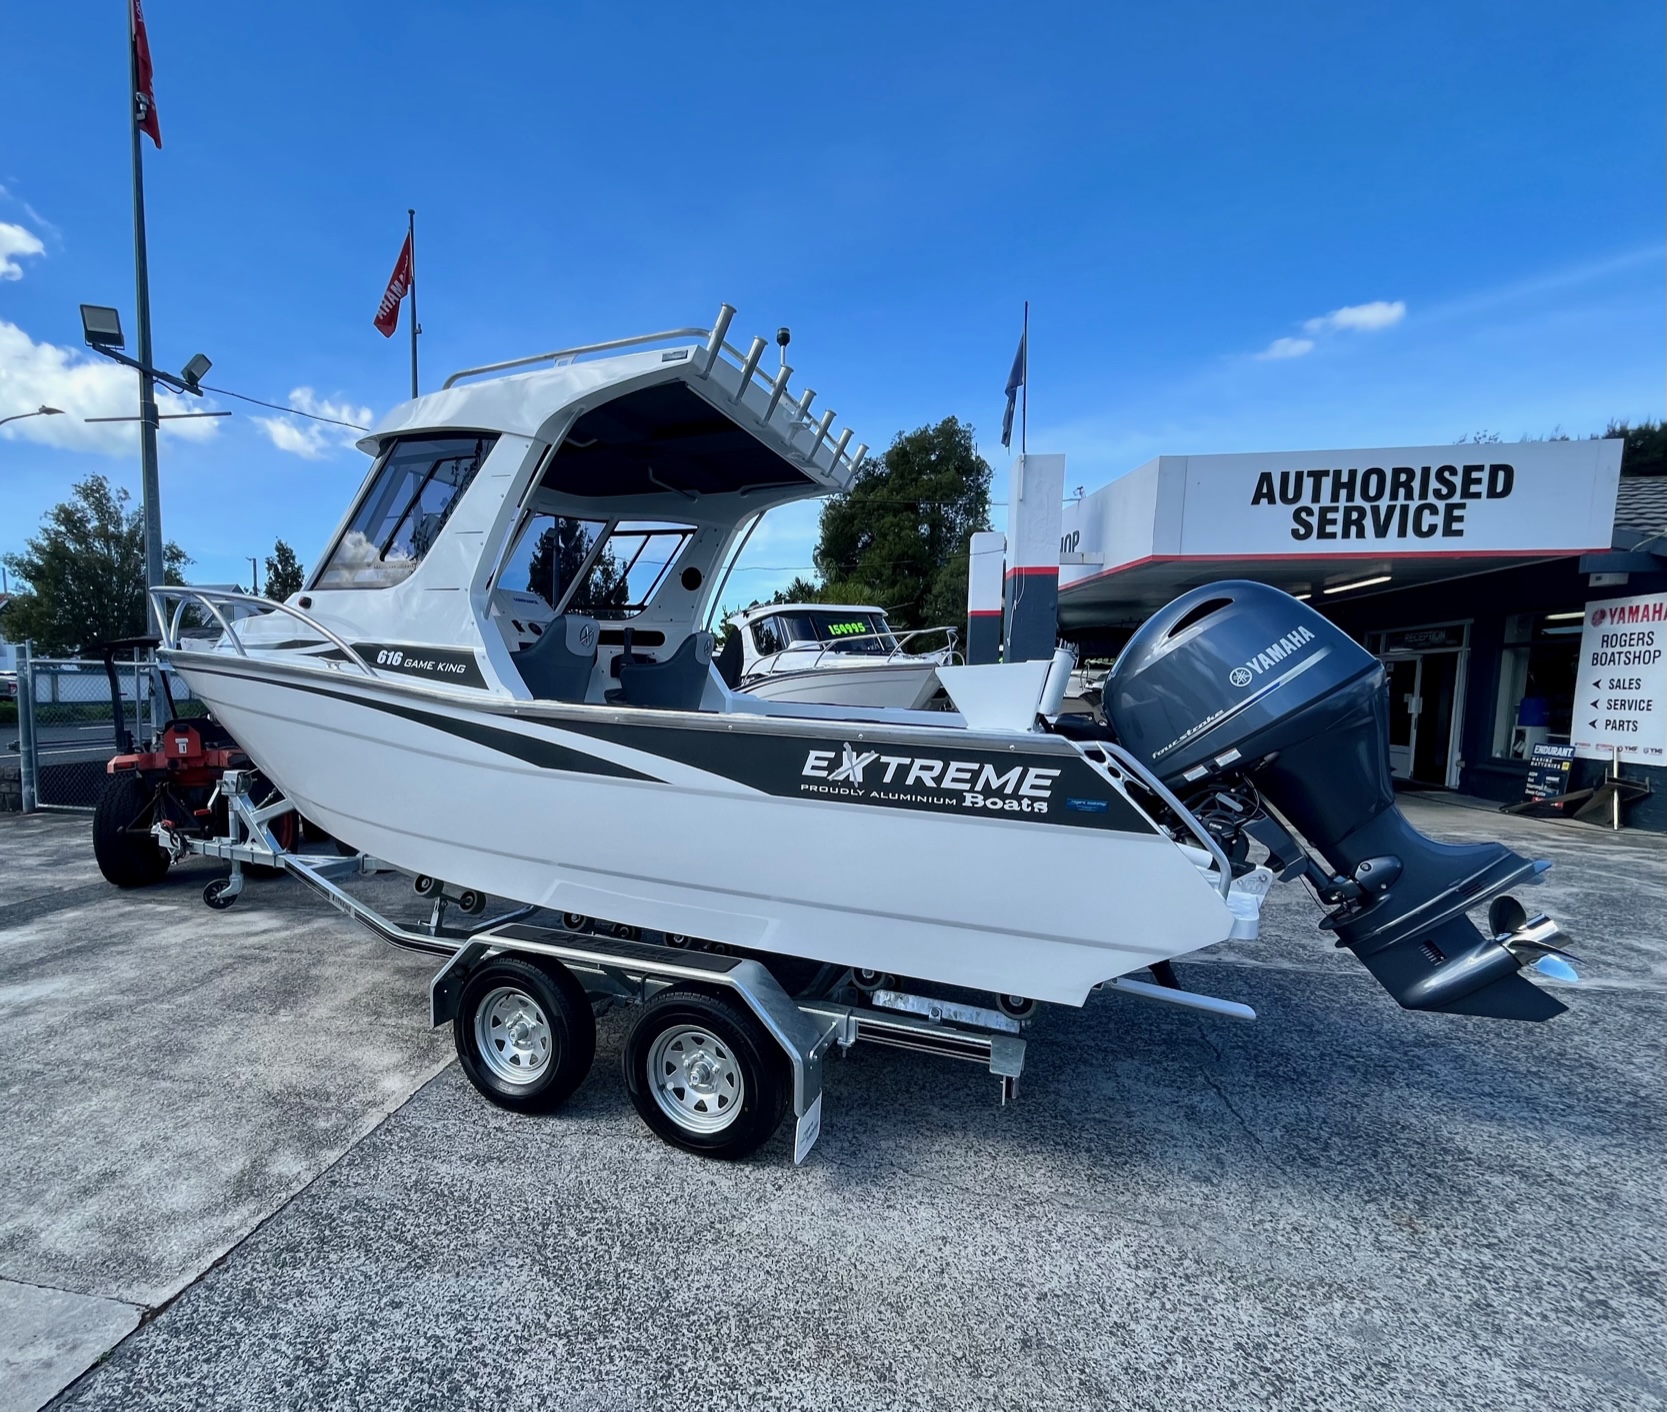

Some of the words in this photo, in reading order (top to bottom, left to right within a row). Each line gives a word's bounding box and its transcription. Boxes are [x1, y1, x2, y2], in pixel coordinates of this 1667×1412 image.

[1250, 463, 1515, 506] AUTHORISED
[1290, 502, 1467, 541] SERVICE
[828, 621, 866, 636] 154995
[1404, 629, 1447, 643] RECEPTION
[1600, 630, 1655, 649] ROGERS
[1246, 625, 1316, 675] YAMAHA
[1591, 649, 1662, 667] BOATSHOP
[376, 649, 404, 666] 616
[403, 658, 436, 670] GAME
[437, 662, 467, 674] KING
[1608, 677, 1642, 690] SALES
[1606, 698, 1653, 712] SERVICE
[1604, 718, 1639, 732] PARTS
[1534, 745, 1573, 757] ENDURANT
[800, 742, 1062, 798] EXTREME
[800, 783, 865, 796] PROUDLY
[869, 790, 957, 806] ALUMINIUM
[961, 792, 1049, 814] Boats
